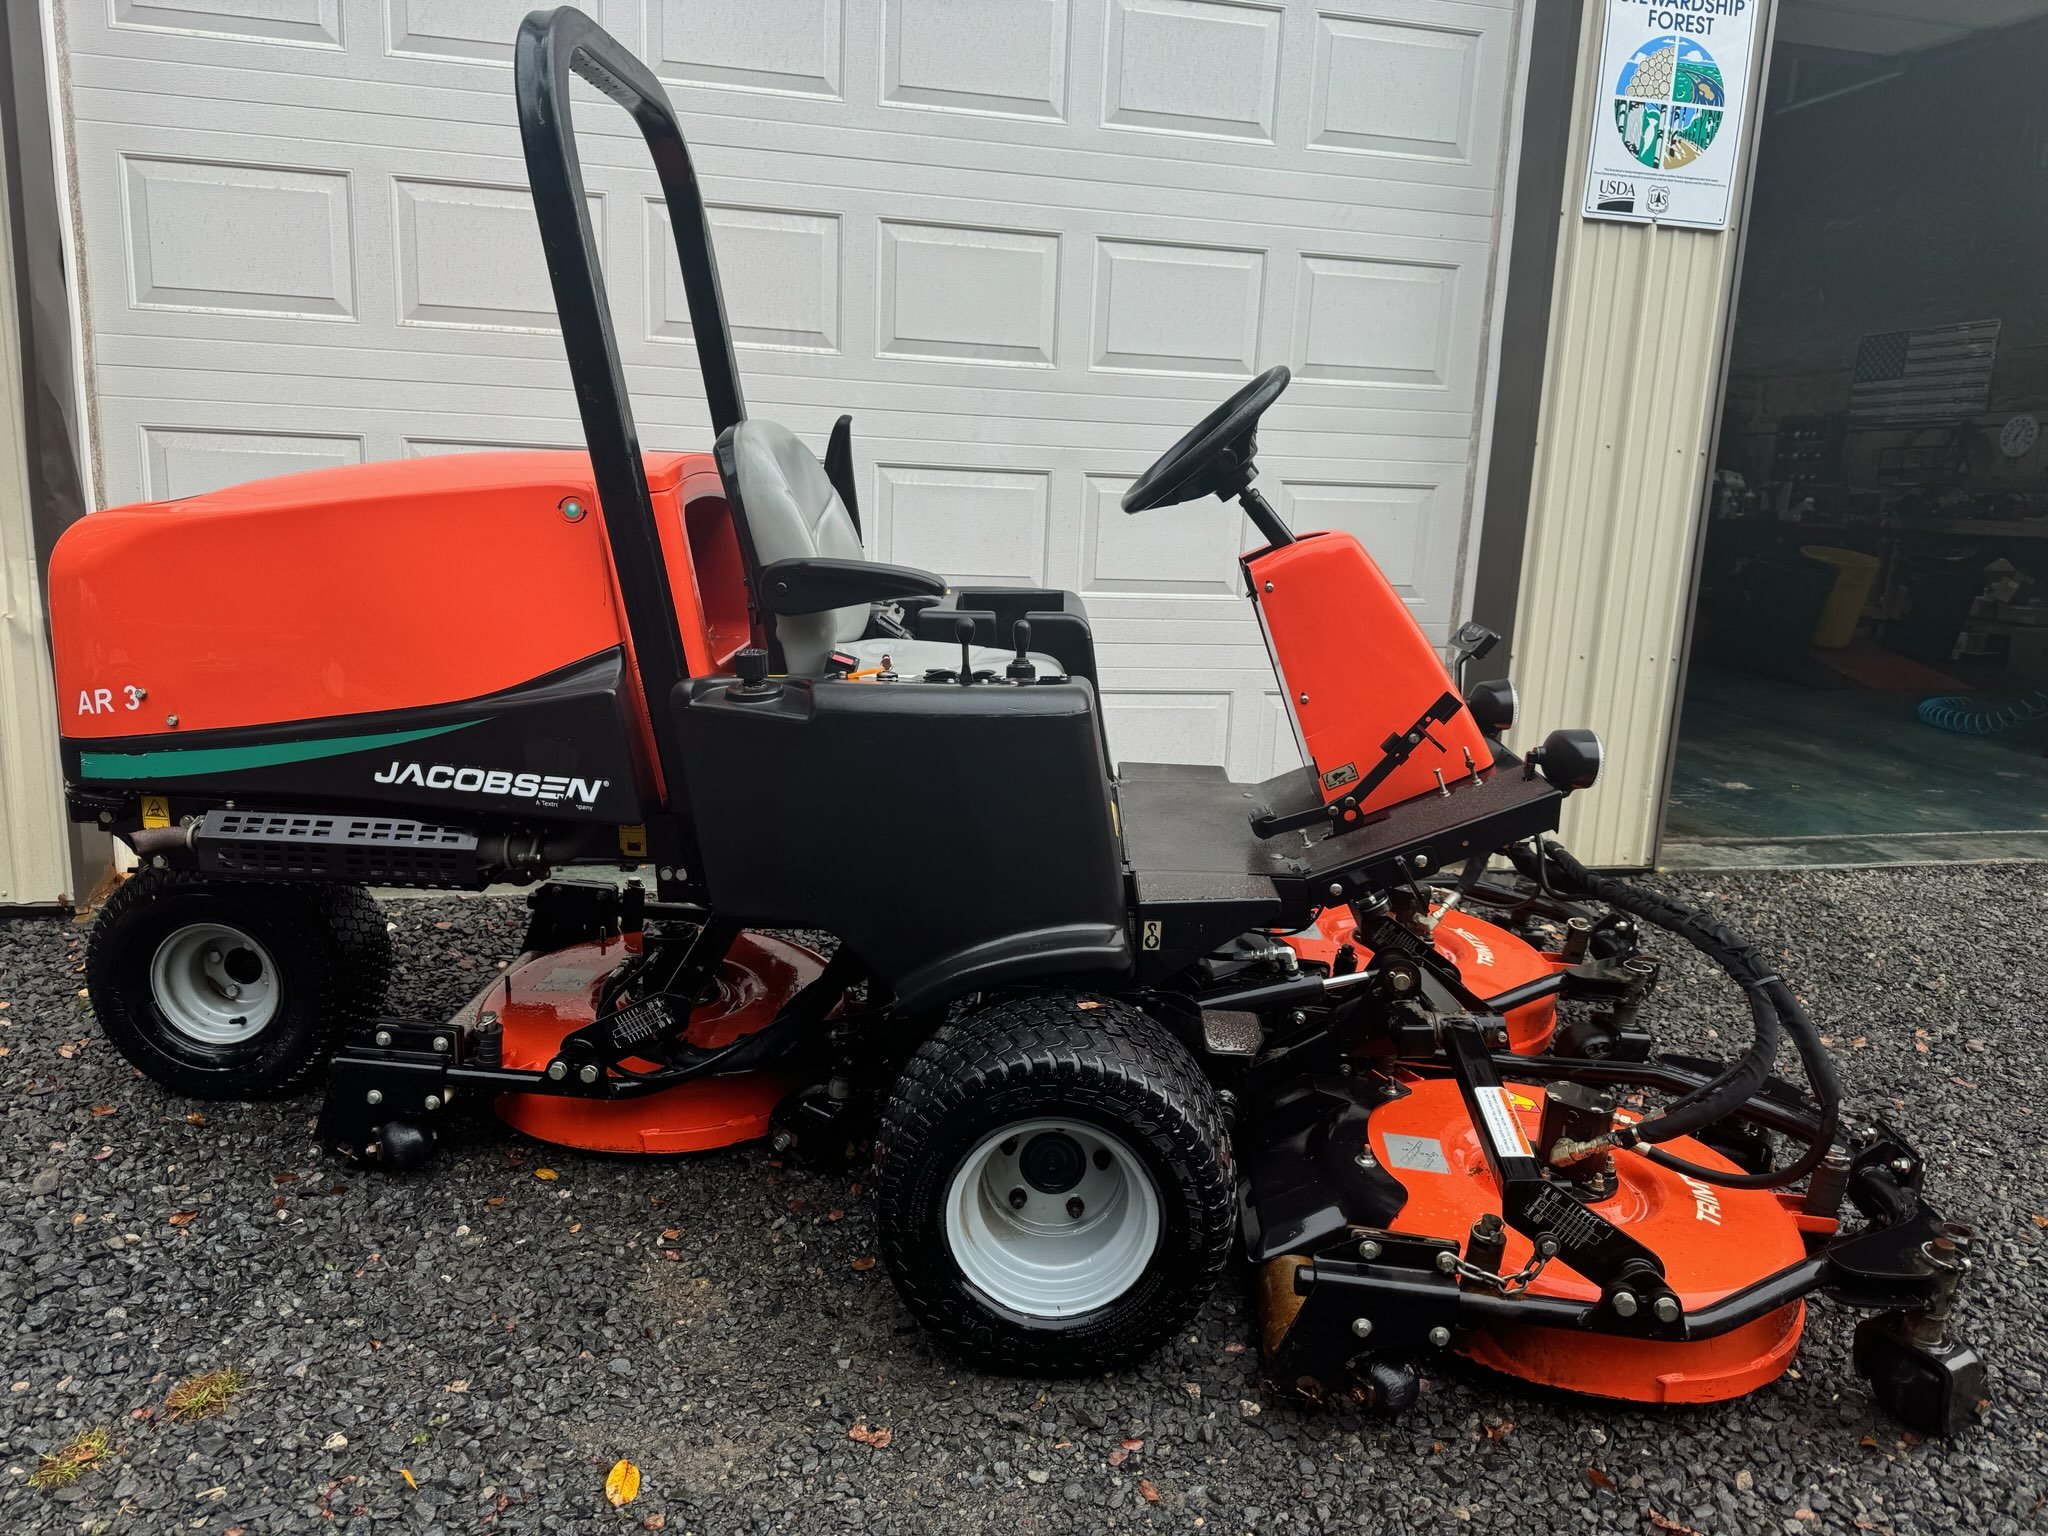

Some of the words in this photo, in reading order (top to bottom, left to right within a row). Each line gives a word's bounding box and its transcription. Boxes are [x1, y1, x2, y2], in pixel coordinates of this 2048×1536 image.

[1648, 9, 1715, 35] FOREST
[1600, 179, 1636, 197] USDA
[78, 688, 115, 716] AR
[123, 684, 140, 711] 3
